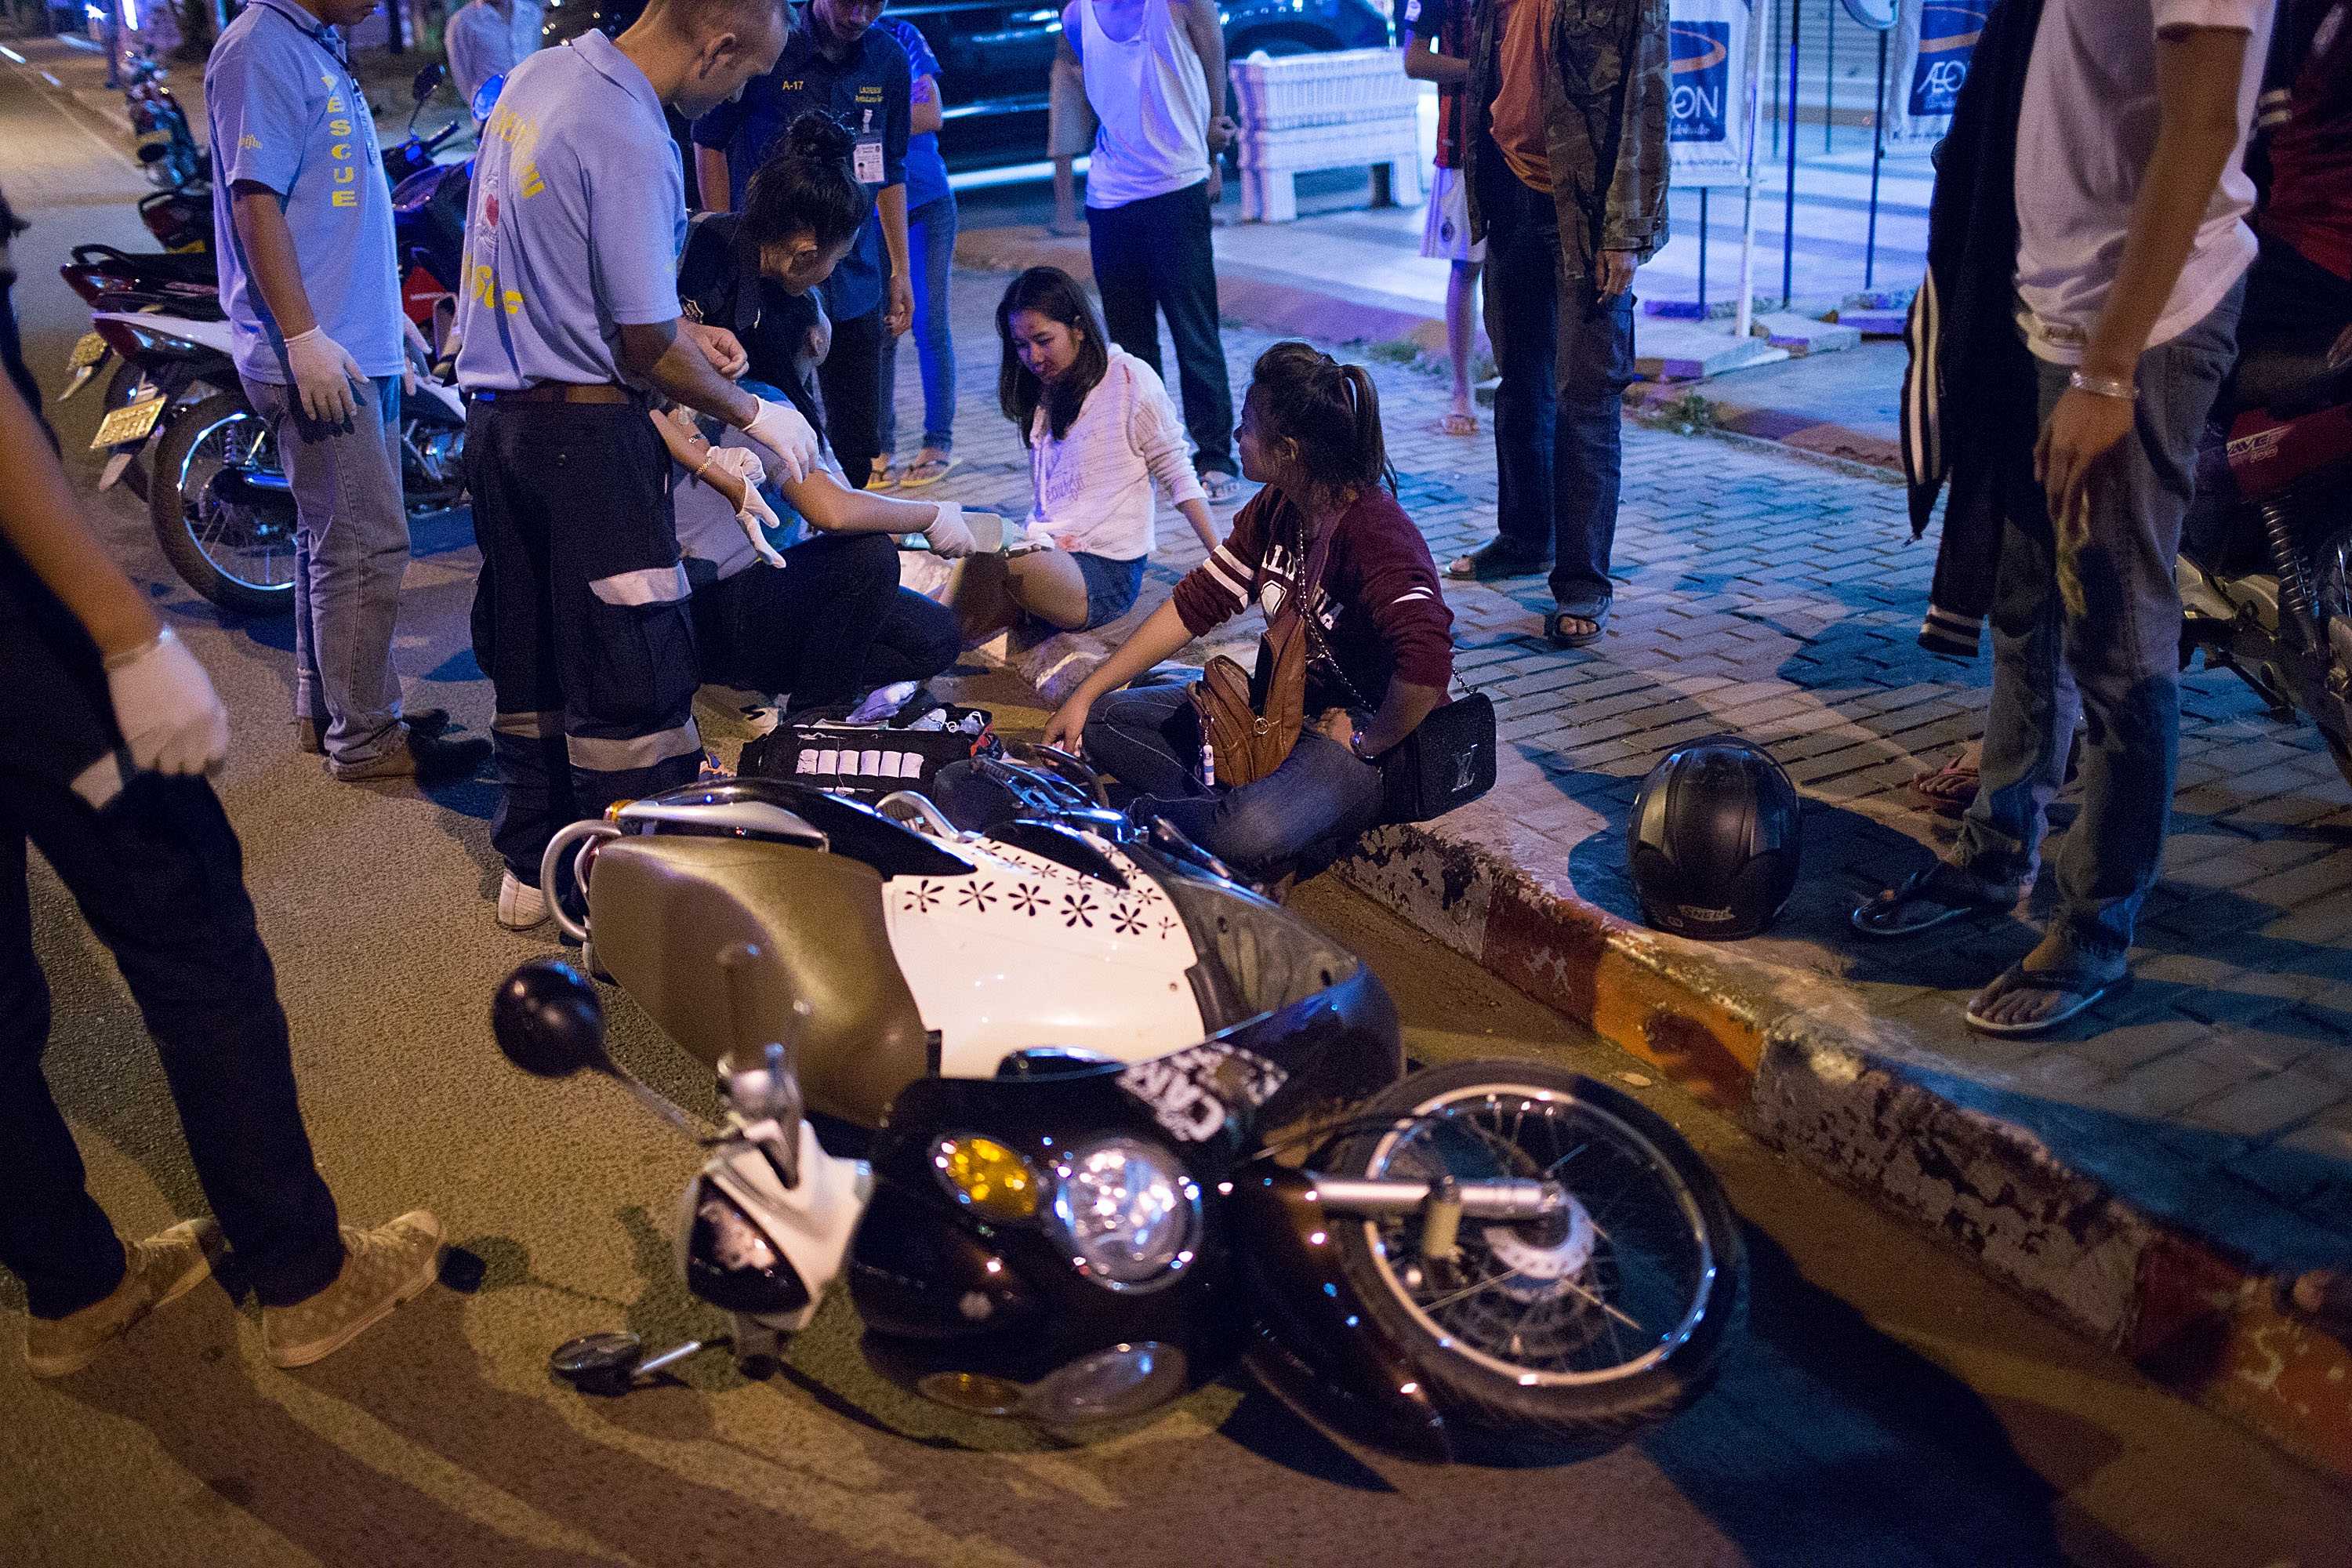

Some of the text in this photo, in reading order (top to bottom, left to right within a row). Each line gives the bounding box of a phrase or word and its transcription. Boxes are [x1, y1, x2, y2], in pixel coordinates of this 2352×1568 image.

[782, 80, 804, 91] A-17
[1671, 85, 1719, 119] ON
[1046, 474, 1086, 504] eautiful
